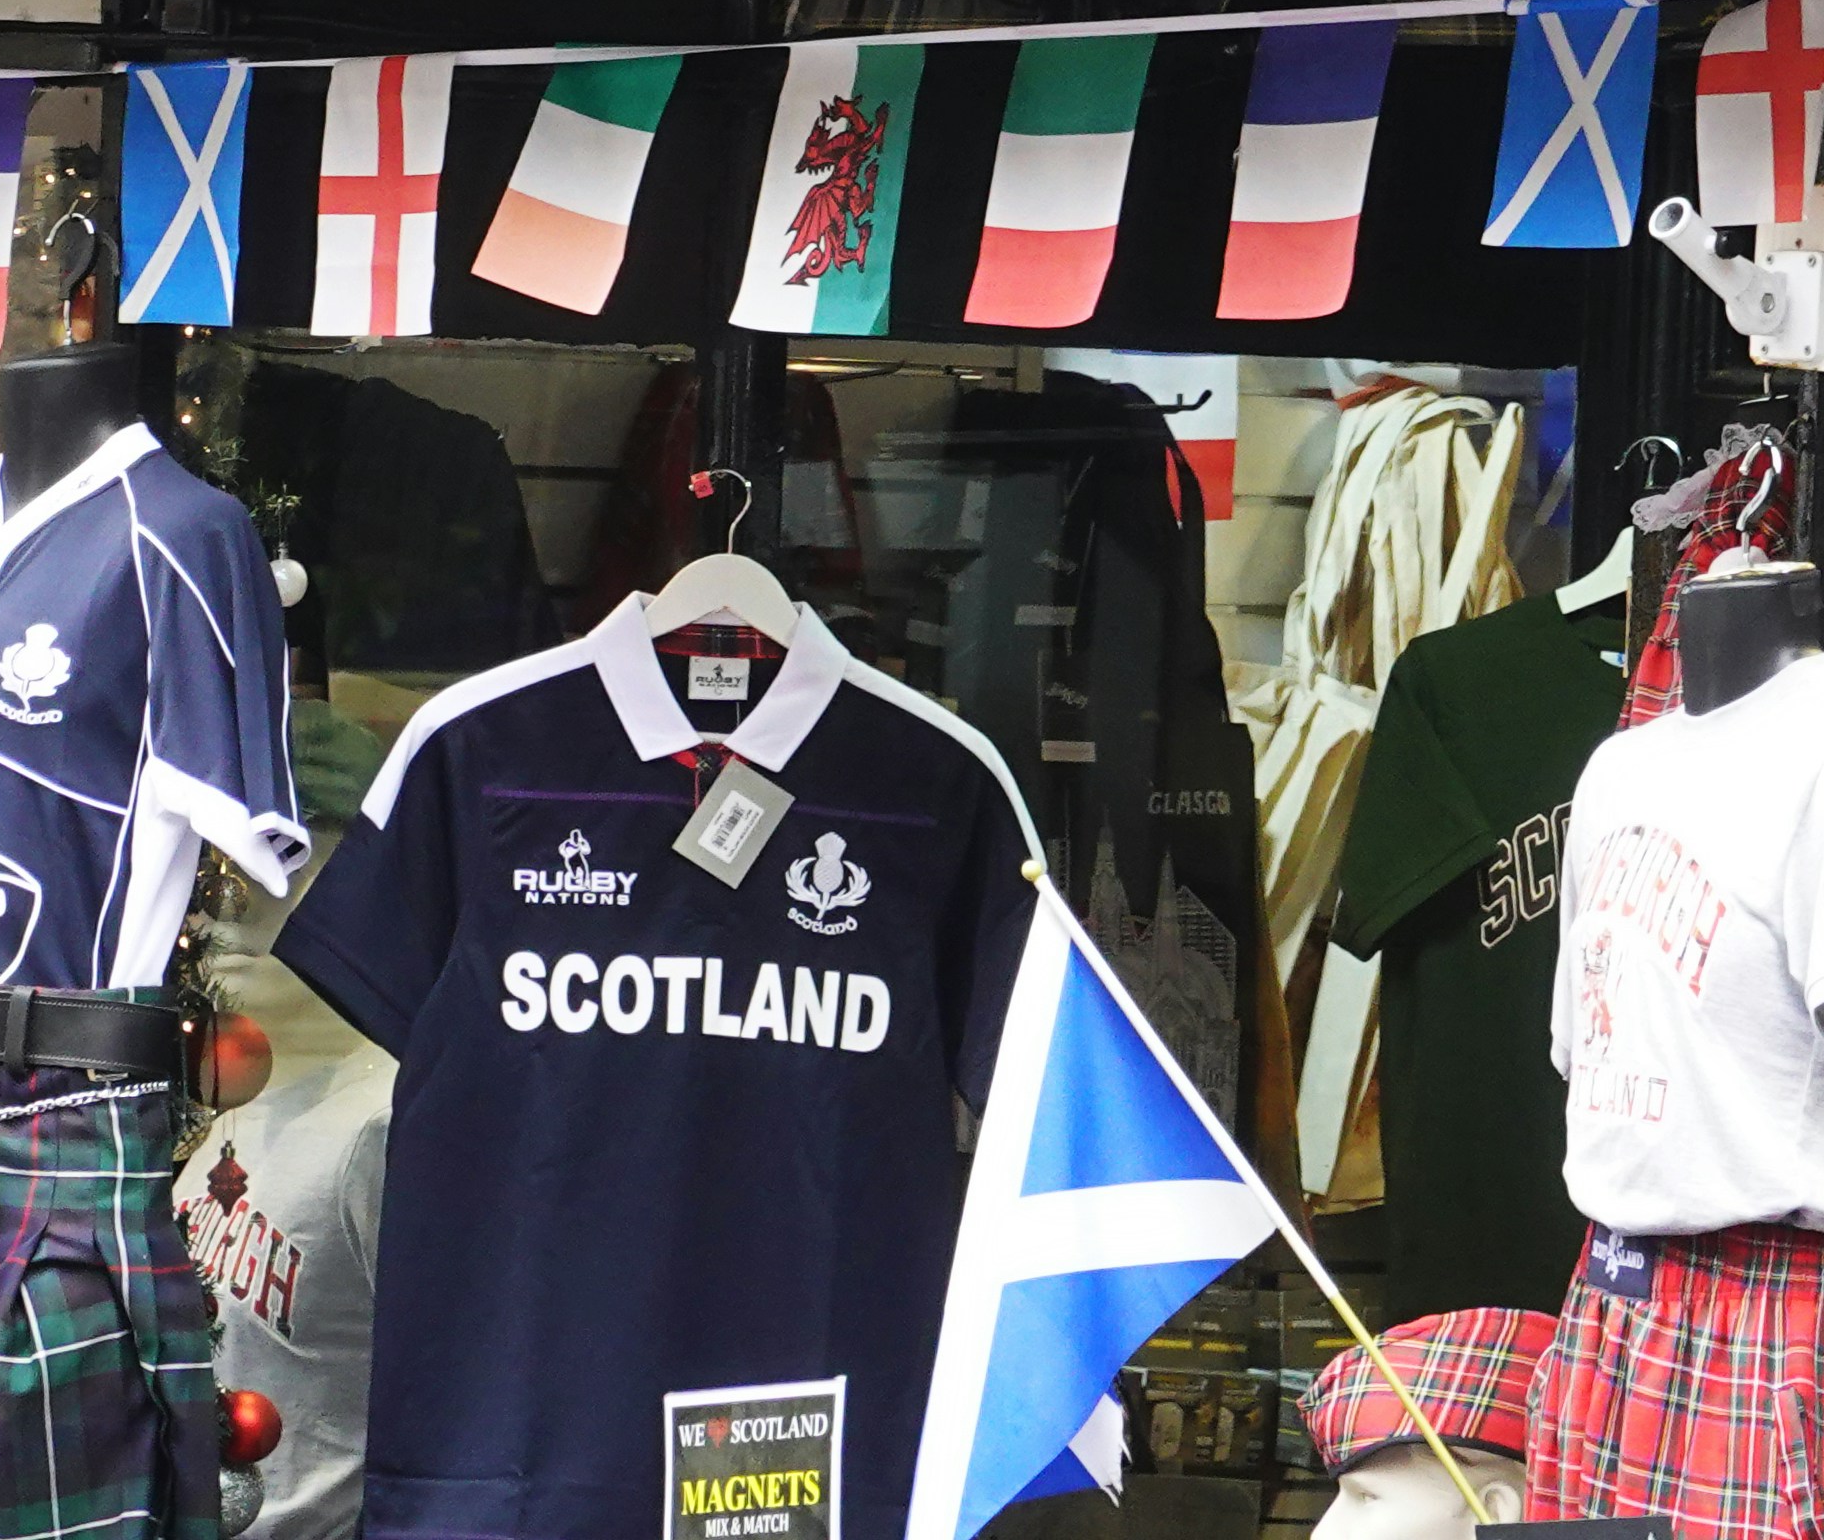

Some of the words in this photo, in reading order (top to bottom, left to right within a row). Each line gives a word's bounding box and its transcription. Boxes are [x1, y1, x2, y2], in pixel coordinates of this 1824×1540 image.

[513, 869, 638, 893] RUGBY
[525, 891, 631, 906] NATIONS
[500, 950, 891, 1053] SCOTLAND
[679, 1423, 706, 1448] WE
[729, 1413, 829, 1444] SCOTLAND
[681, 1470, 821, 1516] MAGNETS
[704, 1516, 730, 1539] MIX
[730, 1516, 742, 1536] &
[743, 1512, 790, 1536] MATCH
